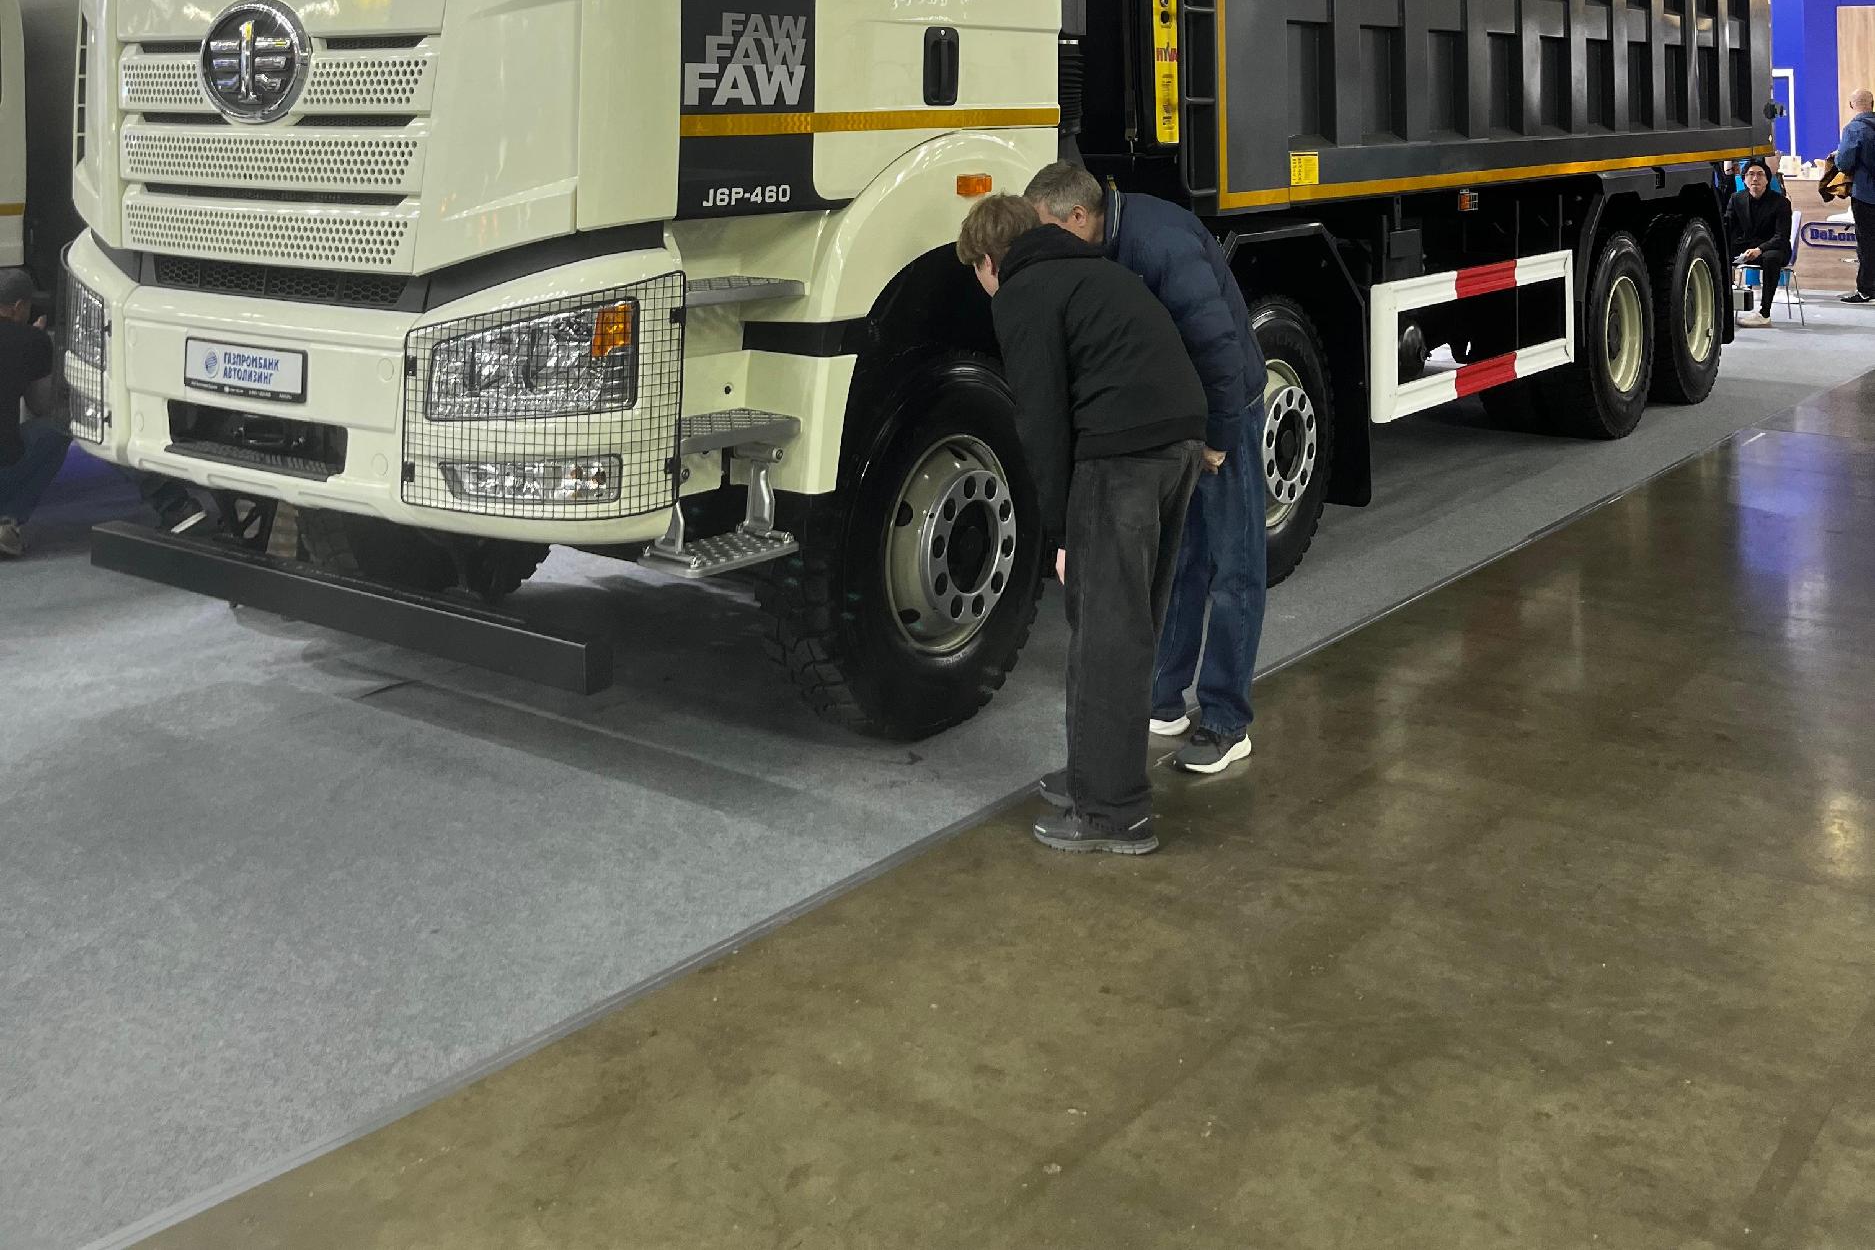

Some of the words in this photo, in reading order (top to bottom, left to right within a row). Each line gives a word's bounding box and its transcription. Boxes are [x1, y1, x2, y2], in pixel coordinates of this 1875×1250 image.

[722, 12, 806, 44] FAW
[705, 35, 806, 71] FAW
[683, 62, 806, 105] FAW
[702, 185, 791, 207] J6P-460
[223, 352, 279, 371] ГАЗПРОМБАНК
[223, 366, 274, 385] АВТОЛИЗИНГ
